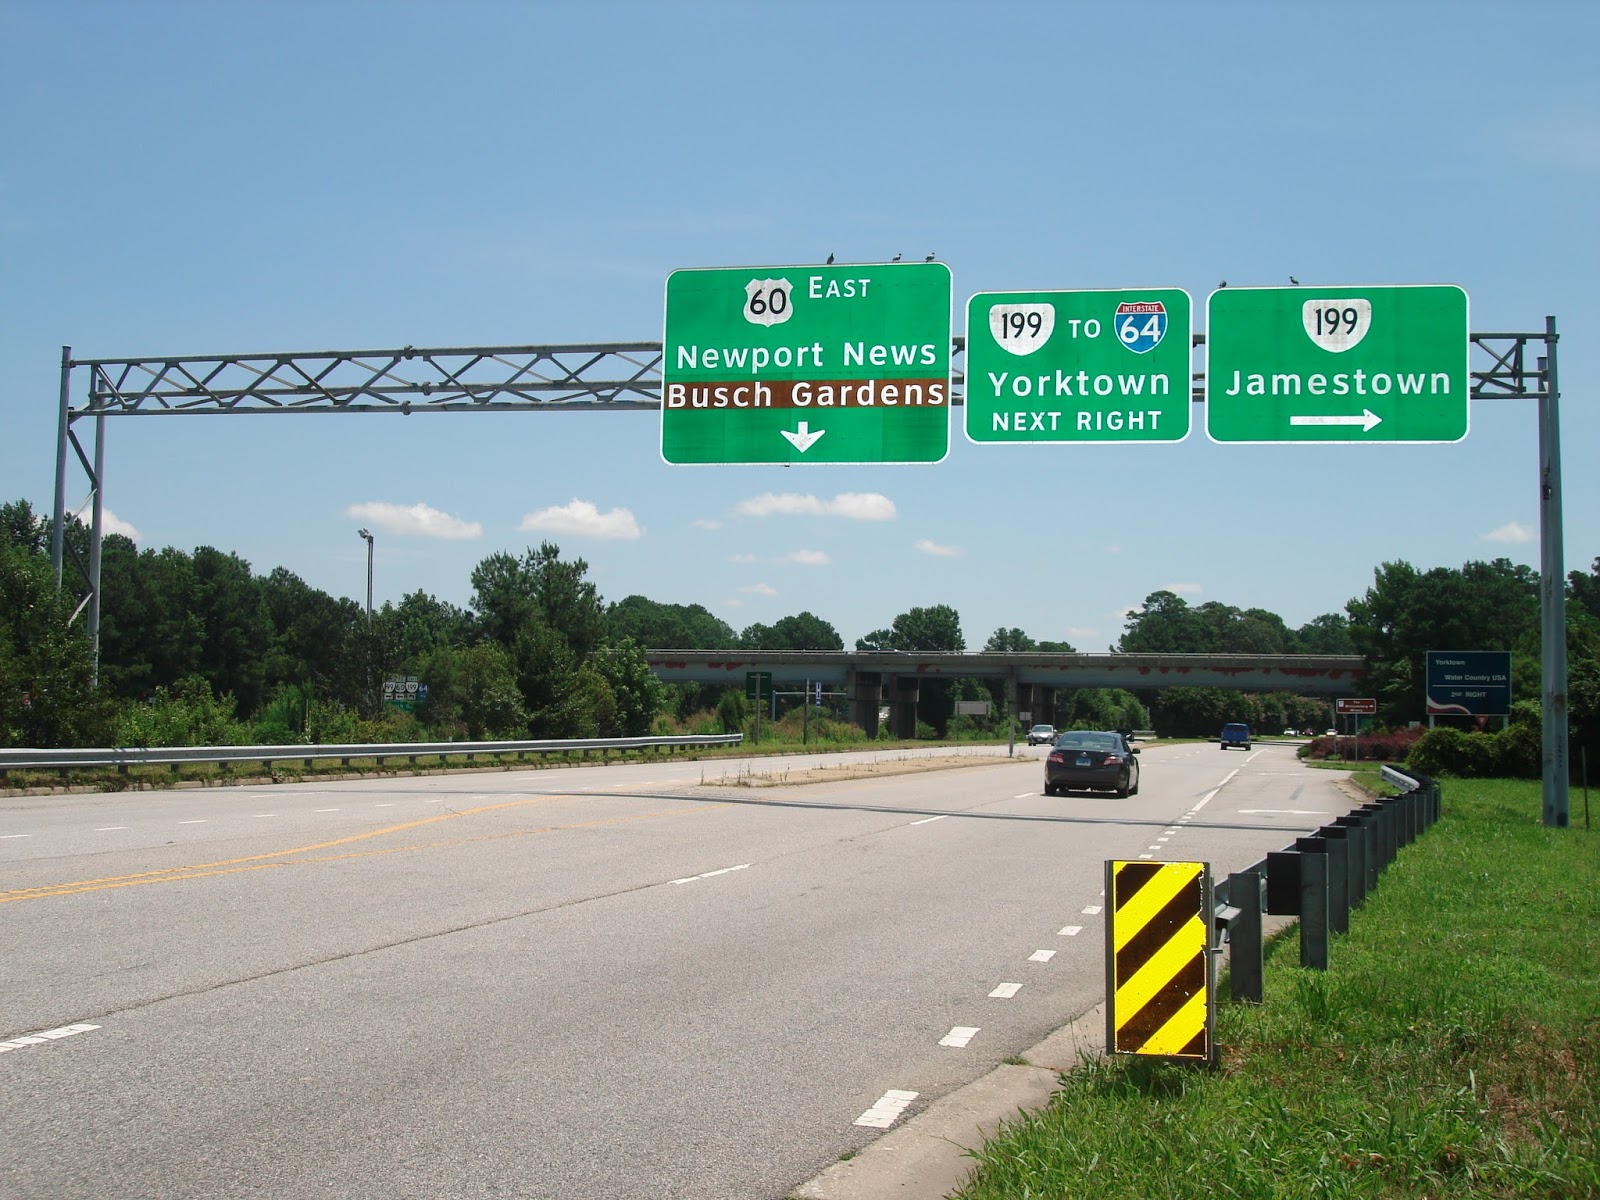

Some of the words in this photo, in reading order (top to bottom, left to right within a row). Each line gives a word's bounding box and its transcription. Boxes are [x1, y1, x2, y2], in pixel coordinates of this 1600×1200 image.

[750, 288, 787, 315] 60
[809, 276, 871, 298] EAST
[1122, 305, 1160, 313] INTERSTATE
[1001, 312, 1042, 339] 199
[1068, 319, 1101, 338] TO
[1120, 314, 1161, 343] 64
[1315, 308, 1358, 336] 199
[677, 342, 823, 374] Newport
[844, 341, 937, 366] News
[668, 382, 772, 408] Busch
[791, 380, 945, 406] Gardens
[988, 370, 1169, 396] Yorktown
[1225, 369, 1450, 395] Jamestown
[992, 412, 1062, 431] NEXT
[1077, 411, 1162, 430] RIGHT
[1464, 674, 1490, 682] Country
